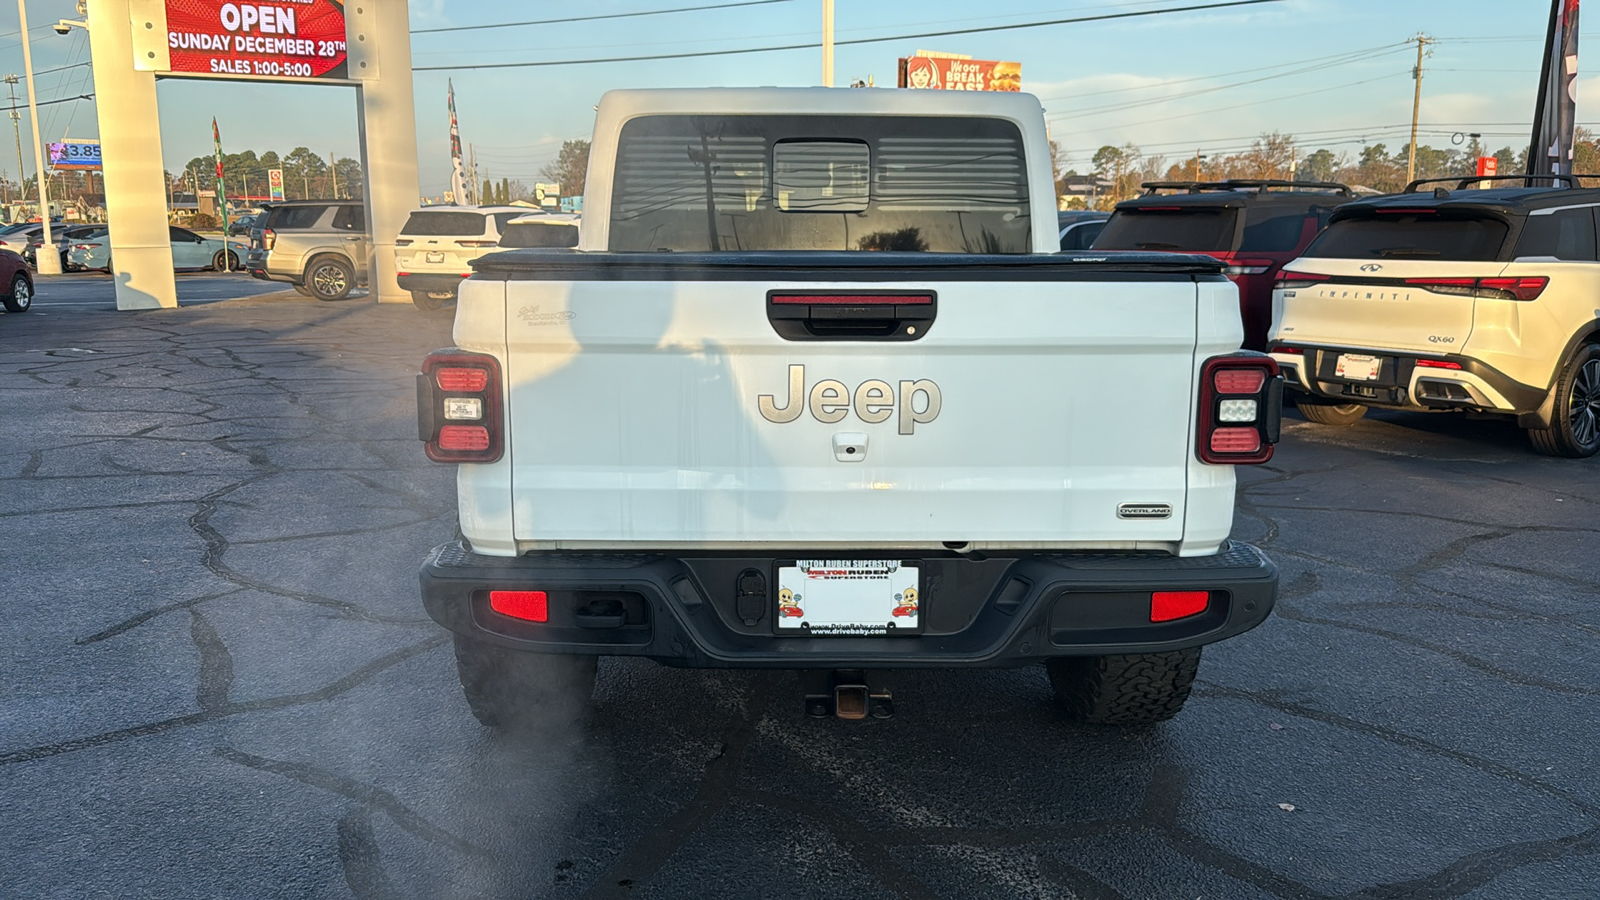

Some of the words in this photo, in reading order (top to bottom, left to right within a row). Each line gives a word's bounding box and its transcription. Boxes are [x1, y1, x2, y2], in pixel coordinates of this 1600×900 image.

[220, 2, 295, 34] OPEN
[168, 32, 231, 51] SUNDAY
[235, 36, 315, 56] DECEMBER
[318, 40, 346, 57] 28TH
[210, 59, 251, 74] SALES
[253, 61, 312, 77] 1:00-5:00
[946, 71, 984, 83] BREAK
[1319, 290, 1411, 301] INFINITI
[1428, 335, 1455, 344] QX60
[758, 364, 942, 435] Jeep
[796, 560, 825, 568] MILTON
[825, 560, 852, 568] RUBEN
[853, 560, 902, 568] SUPERSTORE
[811, 628, 887, 636] www.drivebaby.com
